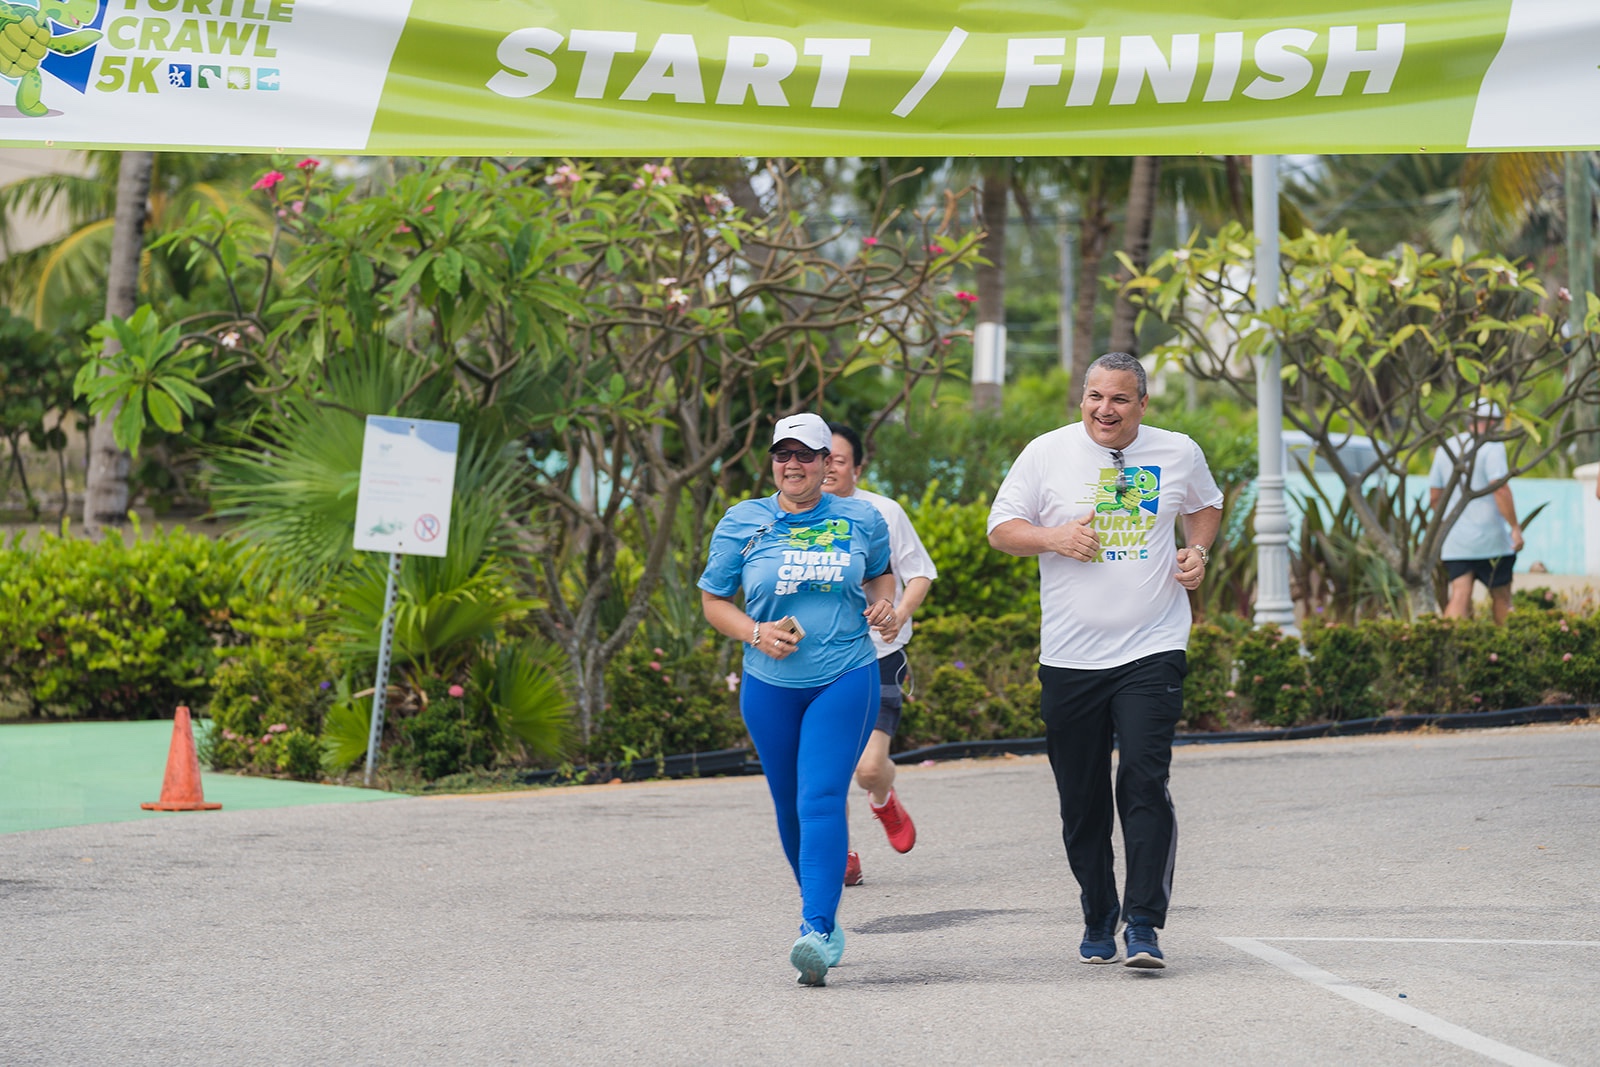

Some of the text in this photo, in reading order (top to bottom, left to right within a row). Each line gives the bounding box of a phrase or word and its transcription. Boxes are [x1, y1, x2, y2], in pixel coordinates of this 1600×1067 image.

[107, 16, 278, 58] CRAWL
[95, 56, 164, 94] 5K
[485, 23, 1406, 118] START / FINISH
[1098, 531, 1149, 547] RAWL
[782, 550, 851, 567] TURTLE
[778, 565, 844, 582] CRAWL
[774, 580, 802, 596] 5K
